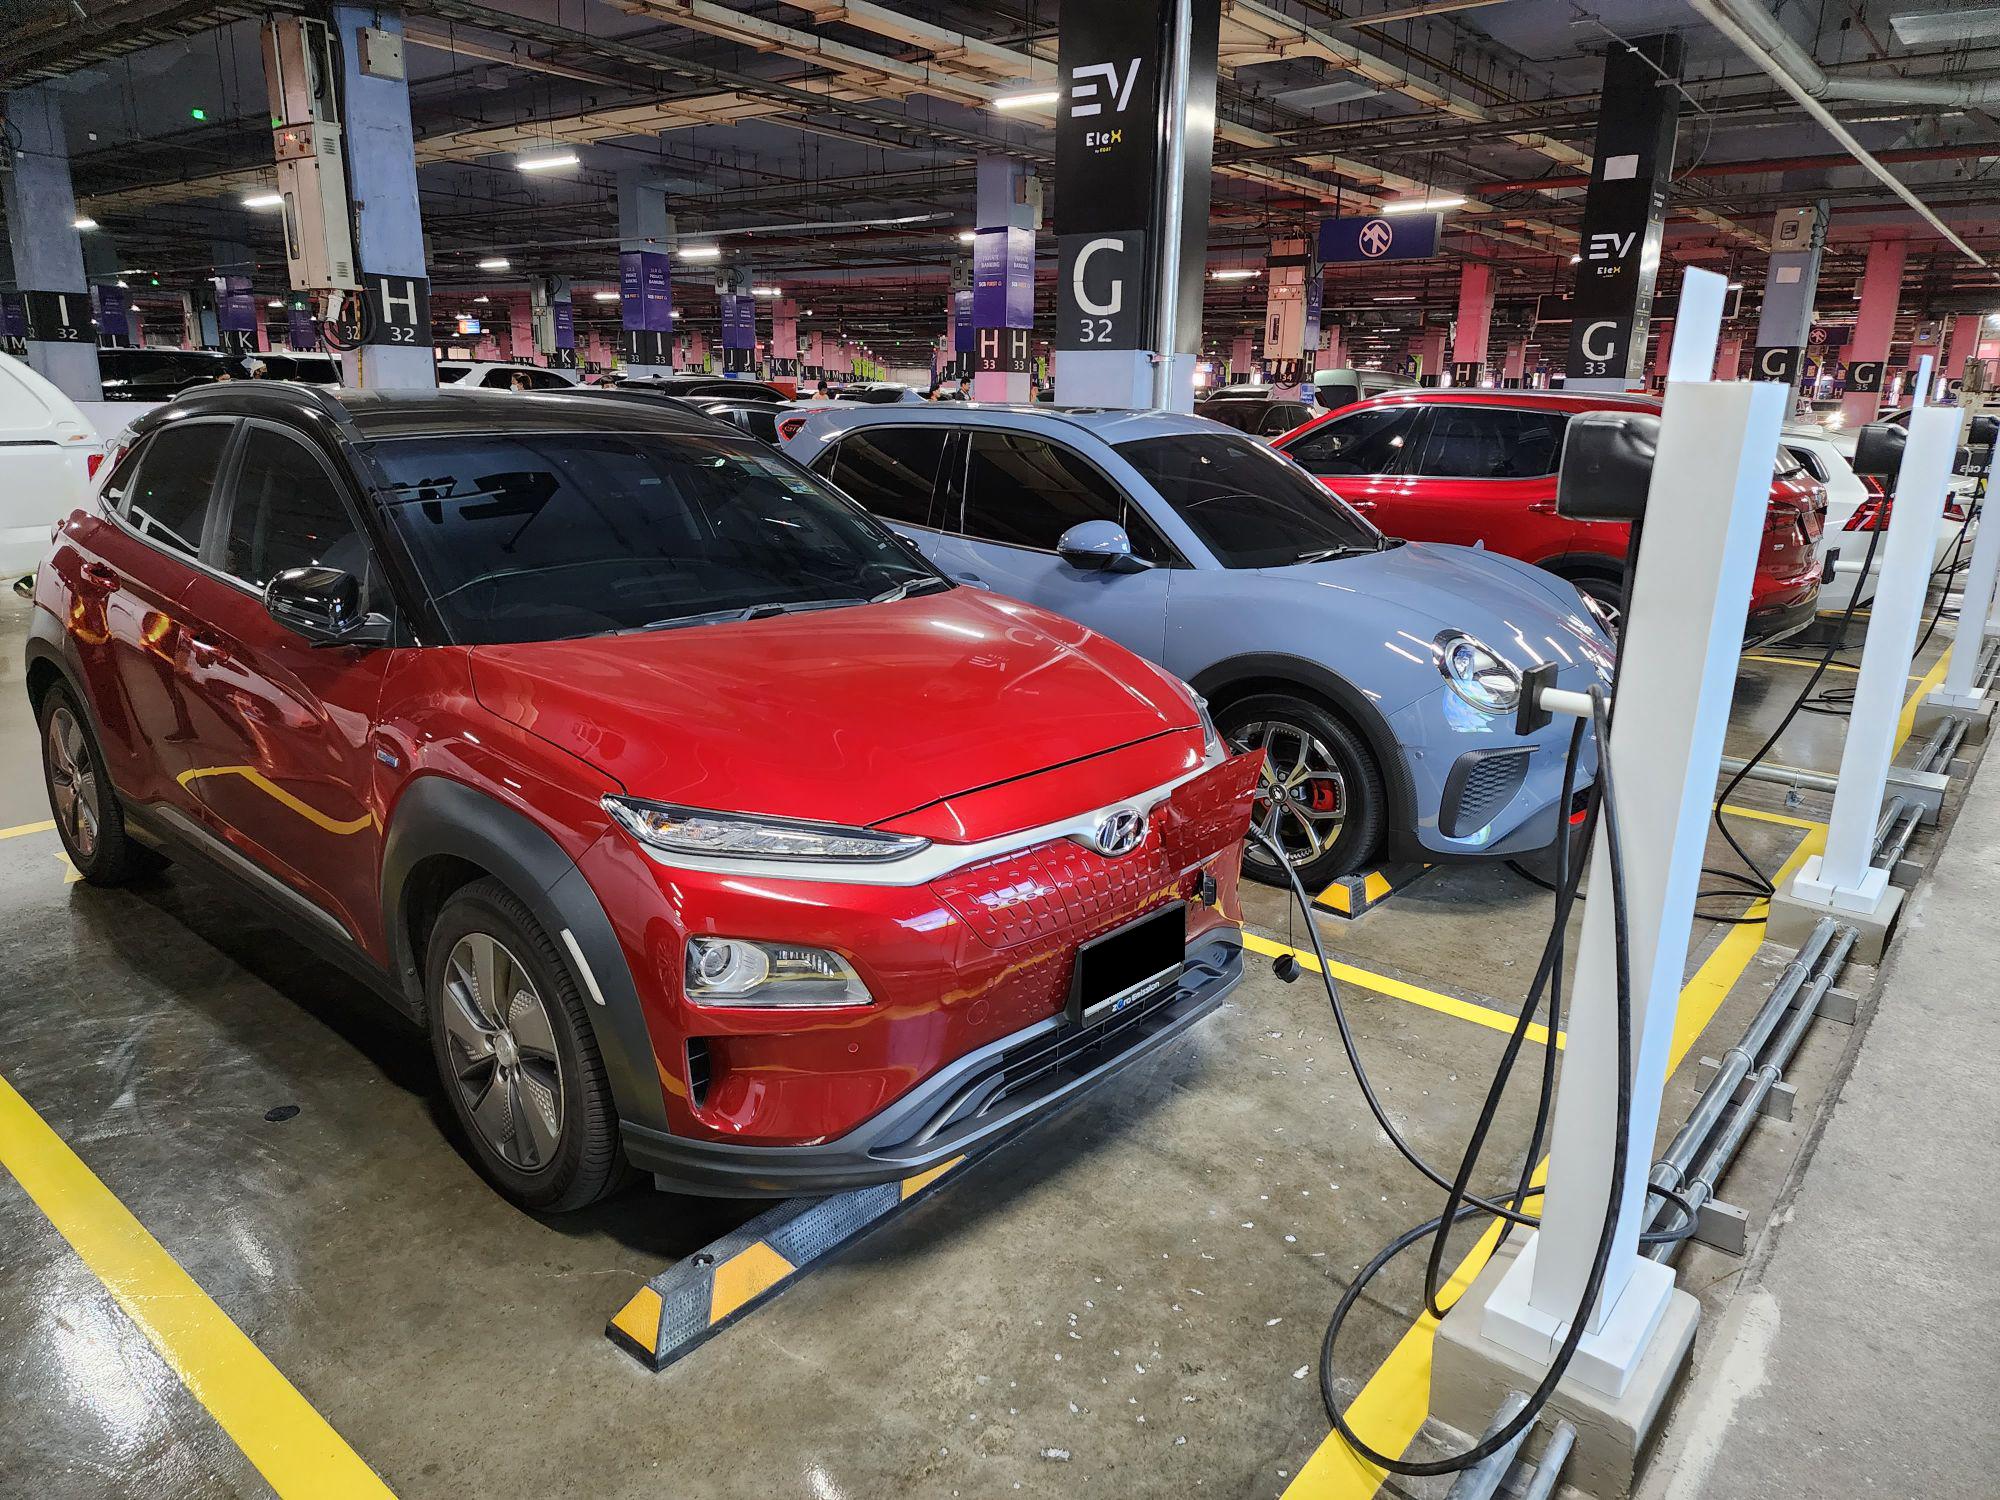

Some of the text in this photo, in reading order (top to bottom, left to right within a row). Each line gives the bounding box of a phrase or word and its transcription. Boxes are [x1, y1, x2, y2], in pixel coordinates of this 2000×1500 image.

[1071, 57, 1142, 118] EV
[1589, 232, 1636, 260] EV
[1073, 238, 1124, 316] G
[380, 278, 418, 325] H
[57, 328, 79, 340] 32
[390, 326, 415, 342] 32
[1080, 319, 1113, 342] 32
[239, 331, 254, 348] K
[981, 329, 999, 359] H
[1012, 330, 1027, 359] H
[1582, 321, 1617, 361] G
[561, 349, 571, 363] K
[631, 354, 640, 363] 33
[655, 356, 666, 364] 33
[983, 360, 996, 369] 33
[1761, 349, 1788, 376] G
[1014, 360, 1024, 370] 33
[1456, 364, 1471, 381] H
[1584, 362, 1606, 375] 33
[1854, 363, 1876, 384] G
[1856, 383, 1868, 391] 35
